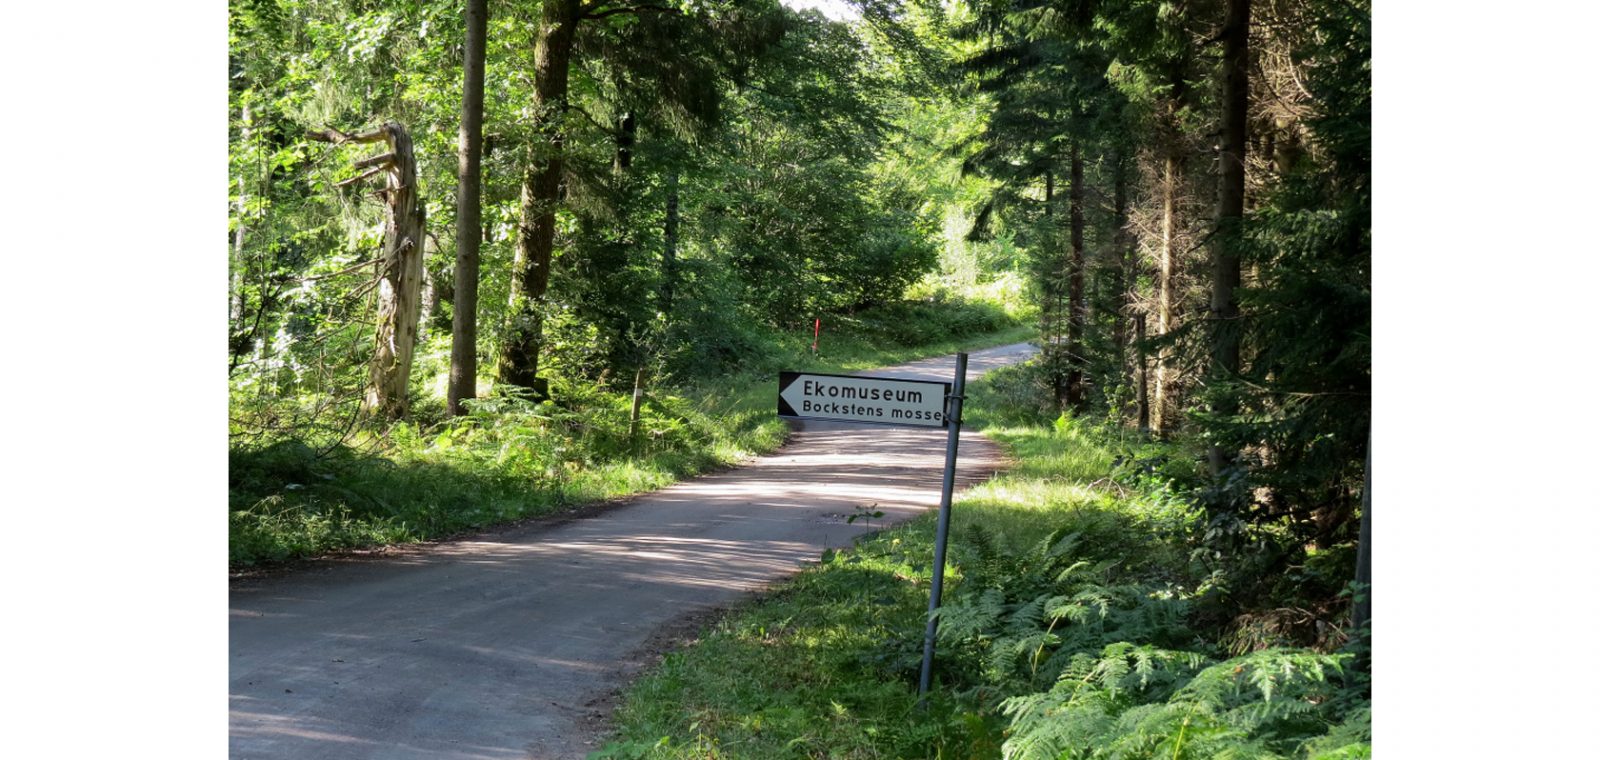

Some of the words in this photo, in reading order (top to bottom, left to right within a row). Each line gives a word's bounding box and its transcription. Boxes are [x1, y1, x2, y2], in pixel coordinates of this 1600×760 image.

[803, 380, 923, 404] Ekomuseum
[802, 400, 883, 417] Bockstens
[891, 408, 942, 421] mosse
